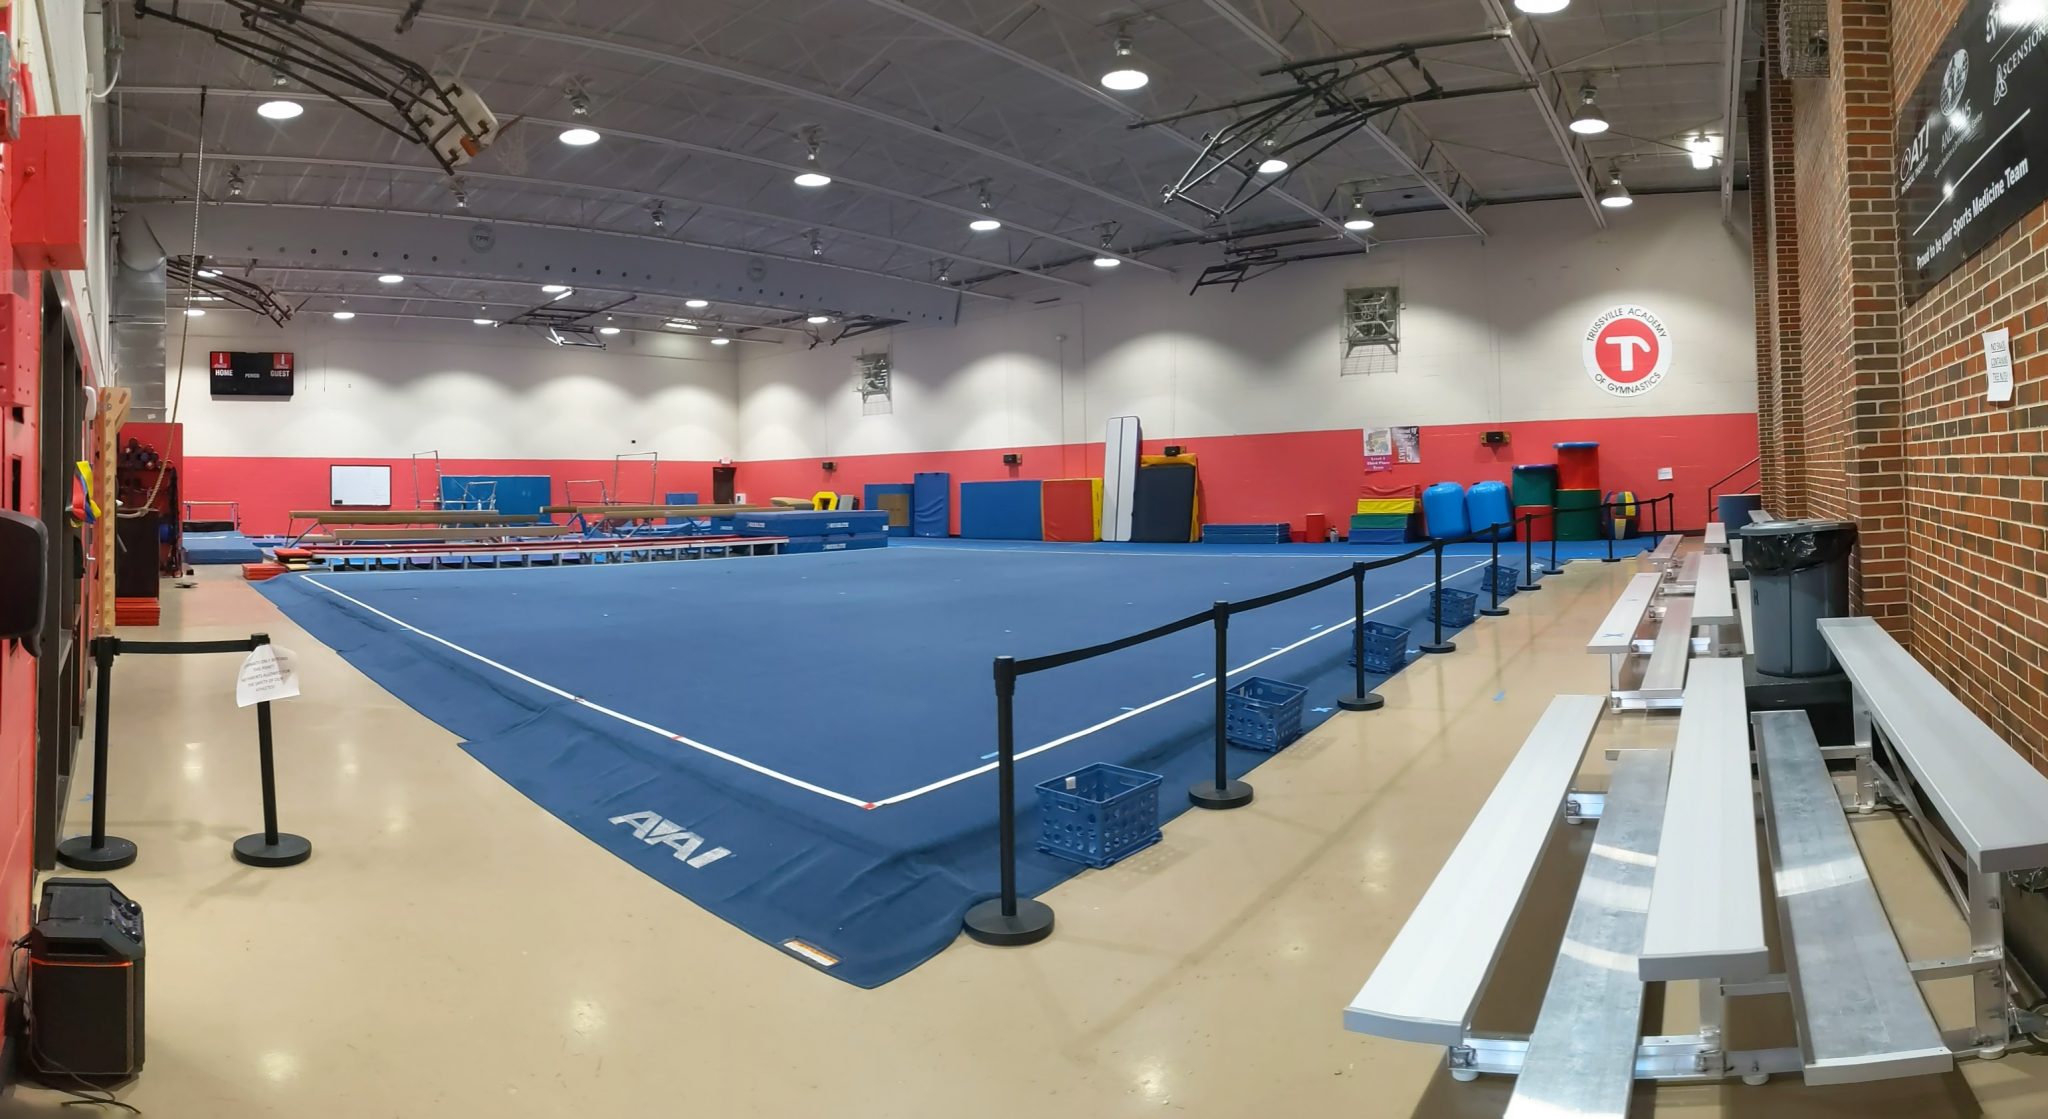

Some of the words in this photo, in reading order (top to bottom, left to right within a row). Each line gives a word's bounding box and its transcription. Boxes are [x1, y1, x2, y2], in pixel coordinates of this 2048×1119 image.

[1910, 119, 1930, 171] ATI
[1916, 247, 1930, 271] Proud
[1929, 244, 1936, 259] to
[1935, 238, 1942, 254] be
[1941, 227, 1953, 252] your
[1952, 207, 1973, 237] Sports
[1972, 179, 2005, 218] Medicine
[2004, 158, 2029, 189] Team
[1586, 308, 1623, 342] TRUSSVILLE
[1627, 308, 1667, 338] ACADEMY
[1594, 373, 1606, 385] OF
[1607, 372, 1661, 395] GYMNASTICS
